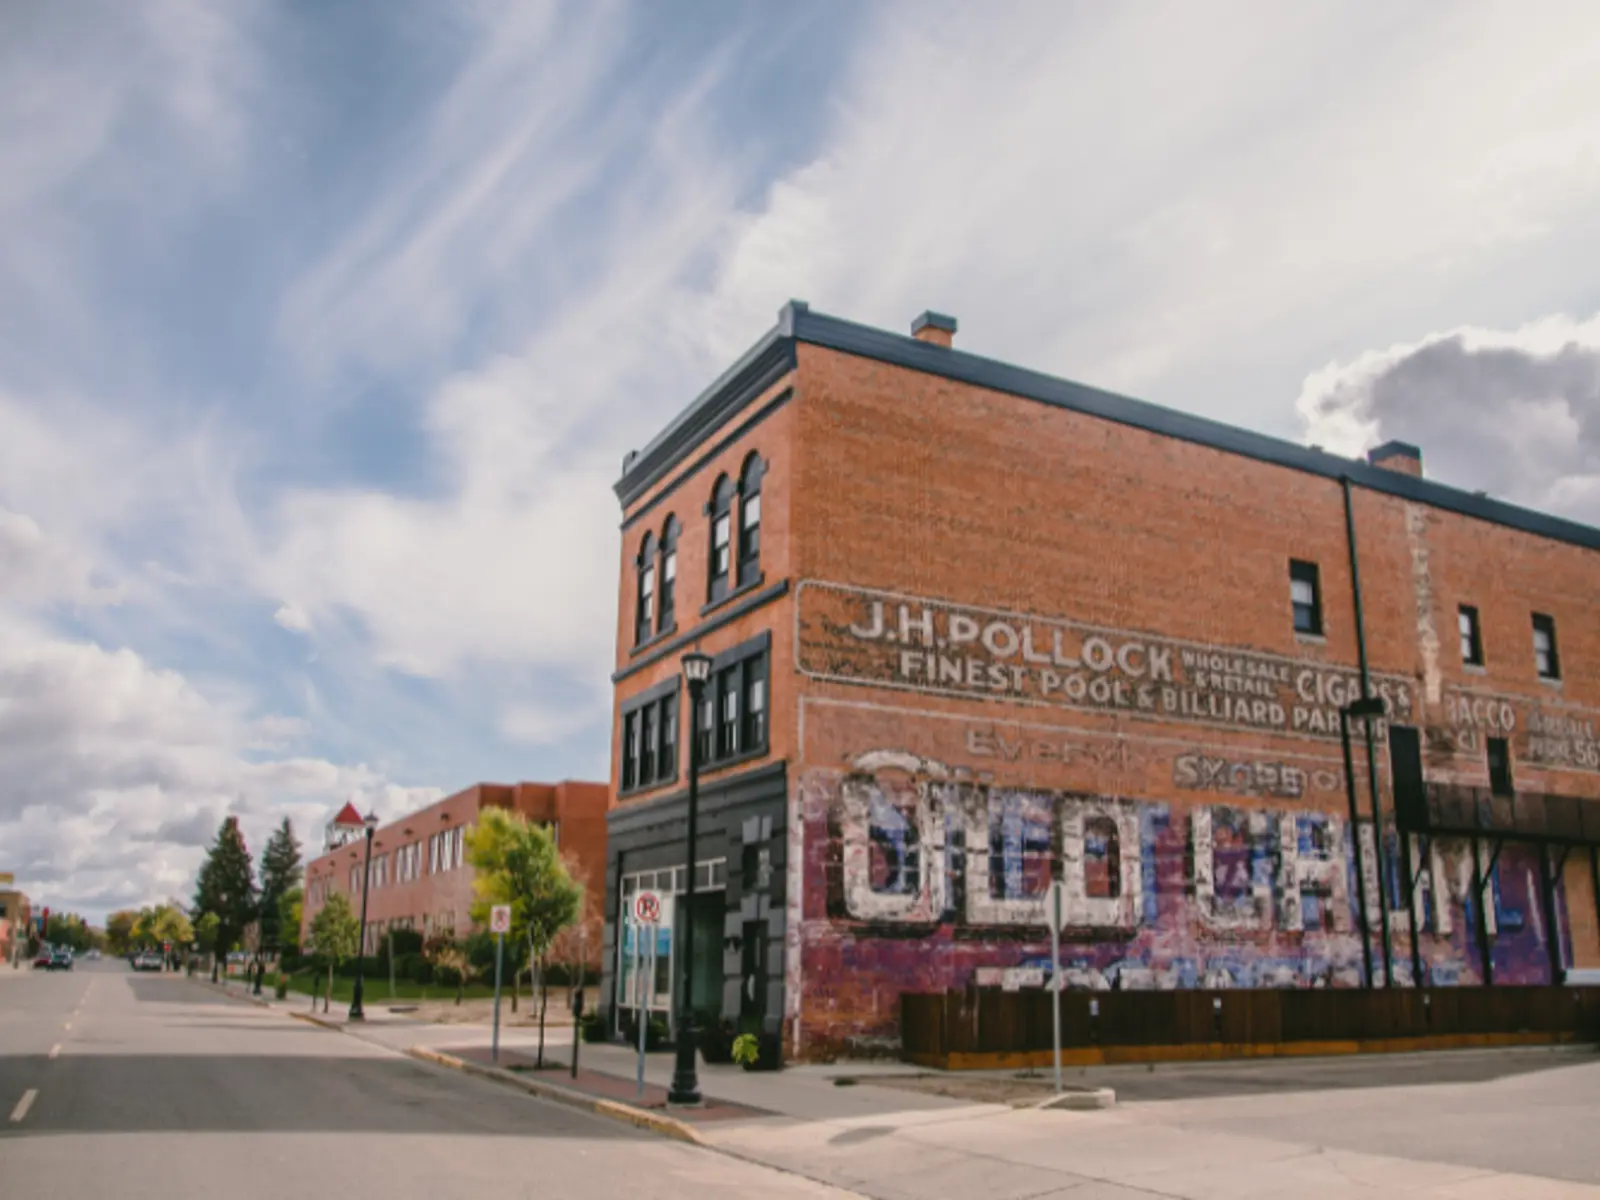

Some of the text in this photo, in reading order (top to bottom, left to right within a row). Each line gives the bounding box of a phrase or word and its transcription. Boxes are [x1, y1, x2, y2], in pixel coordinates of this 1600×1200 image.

[901, 651, 1027, 692] FINEST
[1041, 669, 1131, 706] POOL
[1162, 687, 1287, 726] BILLIARD
